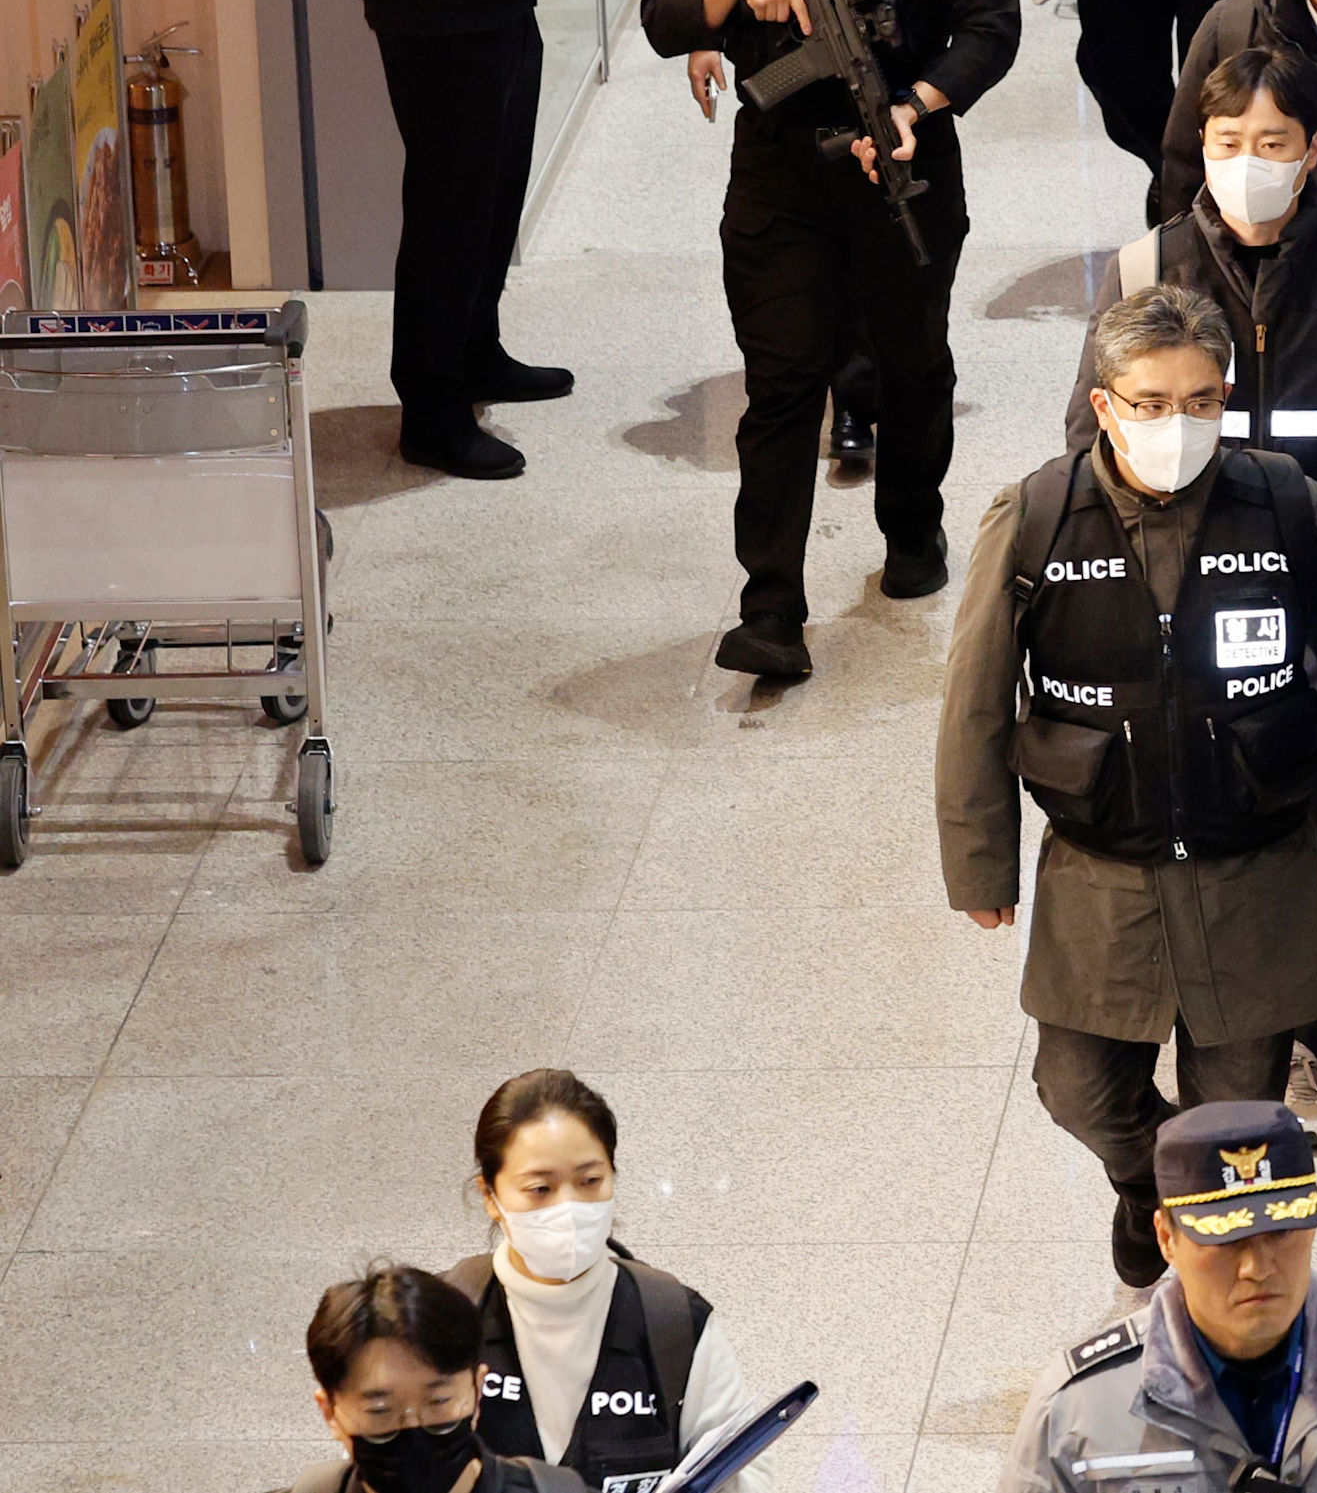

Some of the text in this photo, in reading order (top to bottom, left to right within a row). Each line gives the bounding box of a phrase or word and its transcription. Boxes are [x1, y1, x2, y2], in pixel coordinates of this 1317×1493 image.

[1226, 617, 1278, 642] 형사
[1225, 646, 1279, 659] DETECTIVE
[1042, 675, 1113, 707] POLICE
[1226, 663, 1294, 700] POLICE
